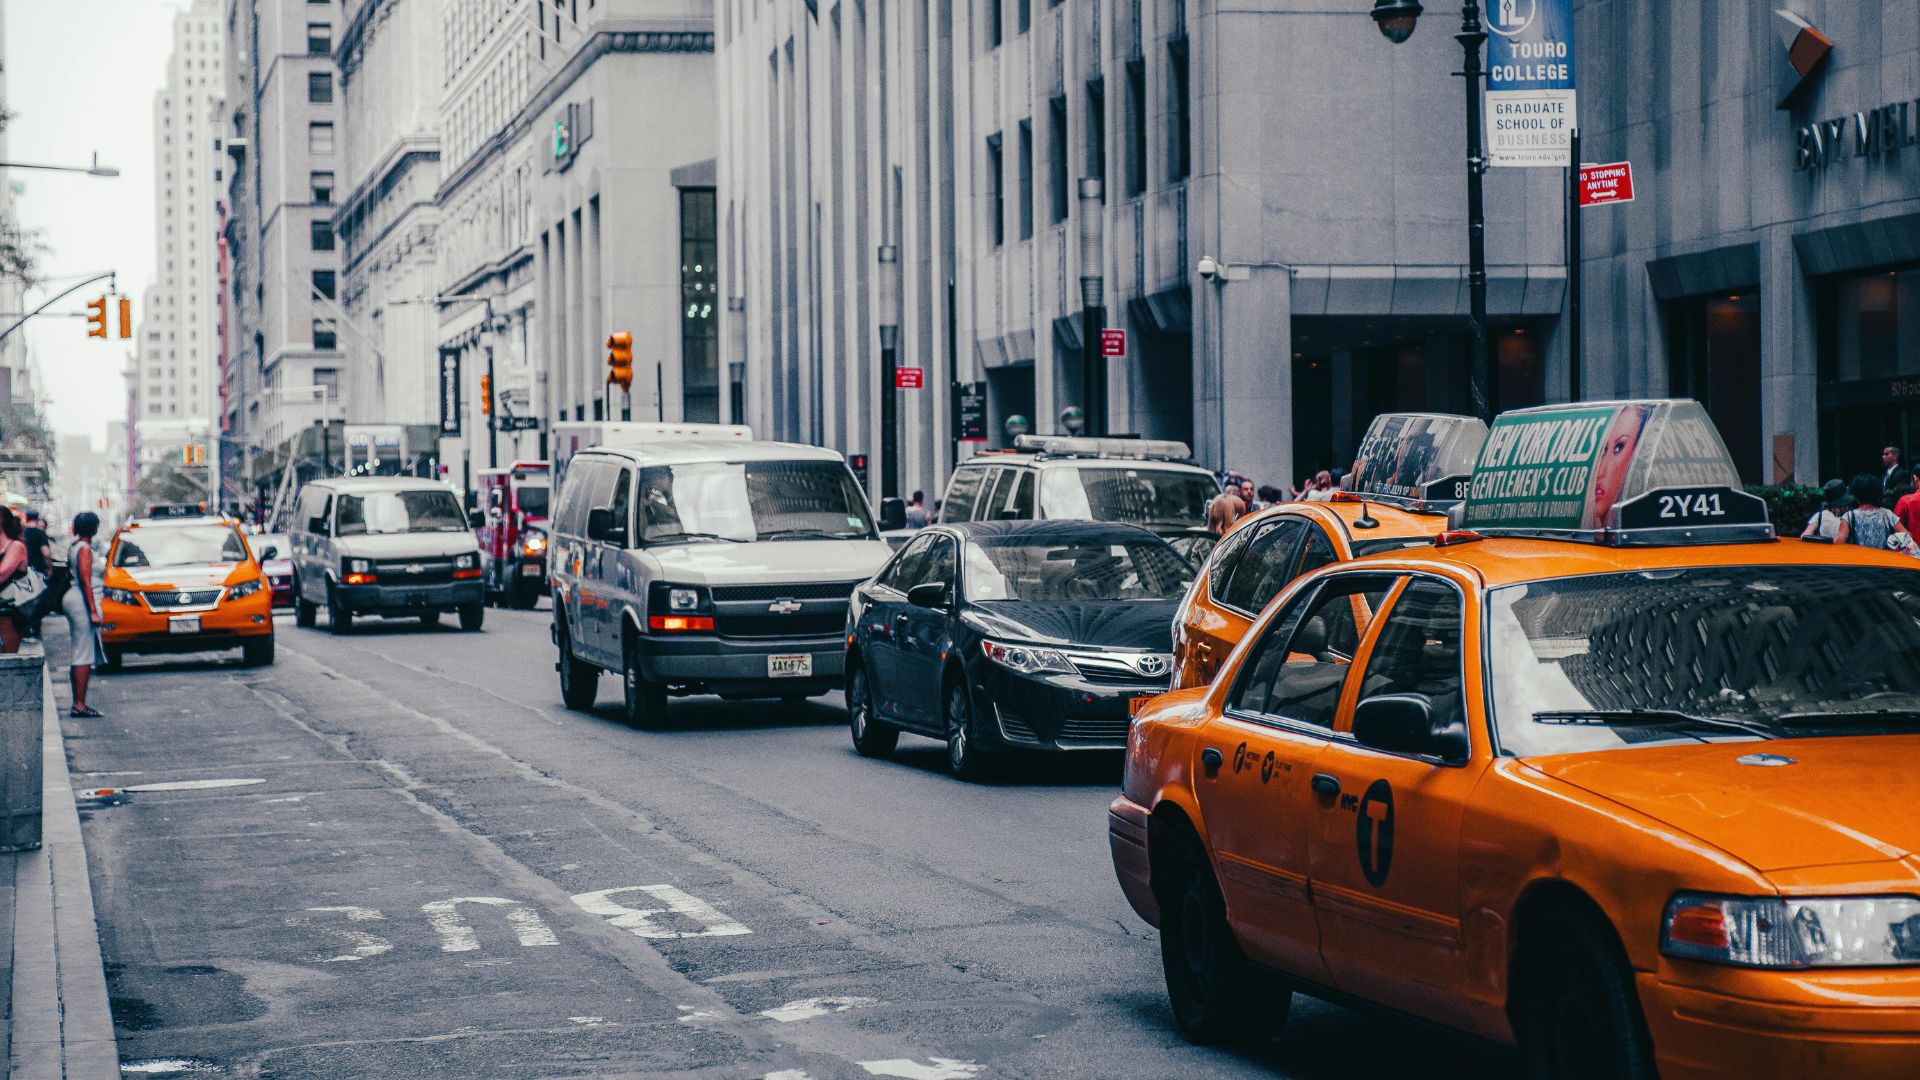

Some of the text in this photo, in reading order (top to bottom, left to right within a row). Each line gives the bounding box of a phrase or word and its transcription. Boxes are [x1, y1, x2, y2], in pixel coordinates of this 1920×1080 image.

[1509, 41, 1567, 59] TOURO
[1492, 63, 1568, 82] COLLEGE
[1496, 102, 1565, 115] GRADUATE
[1497, 117, 1565, 130] SCHOOL OF
[1497, 132, 1566, 146] BUSINESS
[1590, 167, 1626, 181] STOPPING
[1587, 178, 1619, 190] ANYTIME
[1478, 423, 1522, 469] NEW
[1511, 419, 1560, 466] YORK
[1547, 415, 1607, 464] DOLLS
[1471, 465, 1589, 500] GENTLEMEN'S CLUB
[1659, 493, 1725, 518] 2Y41
[1341, 792, 1359, 813] NYC
